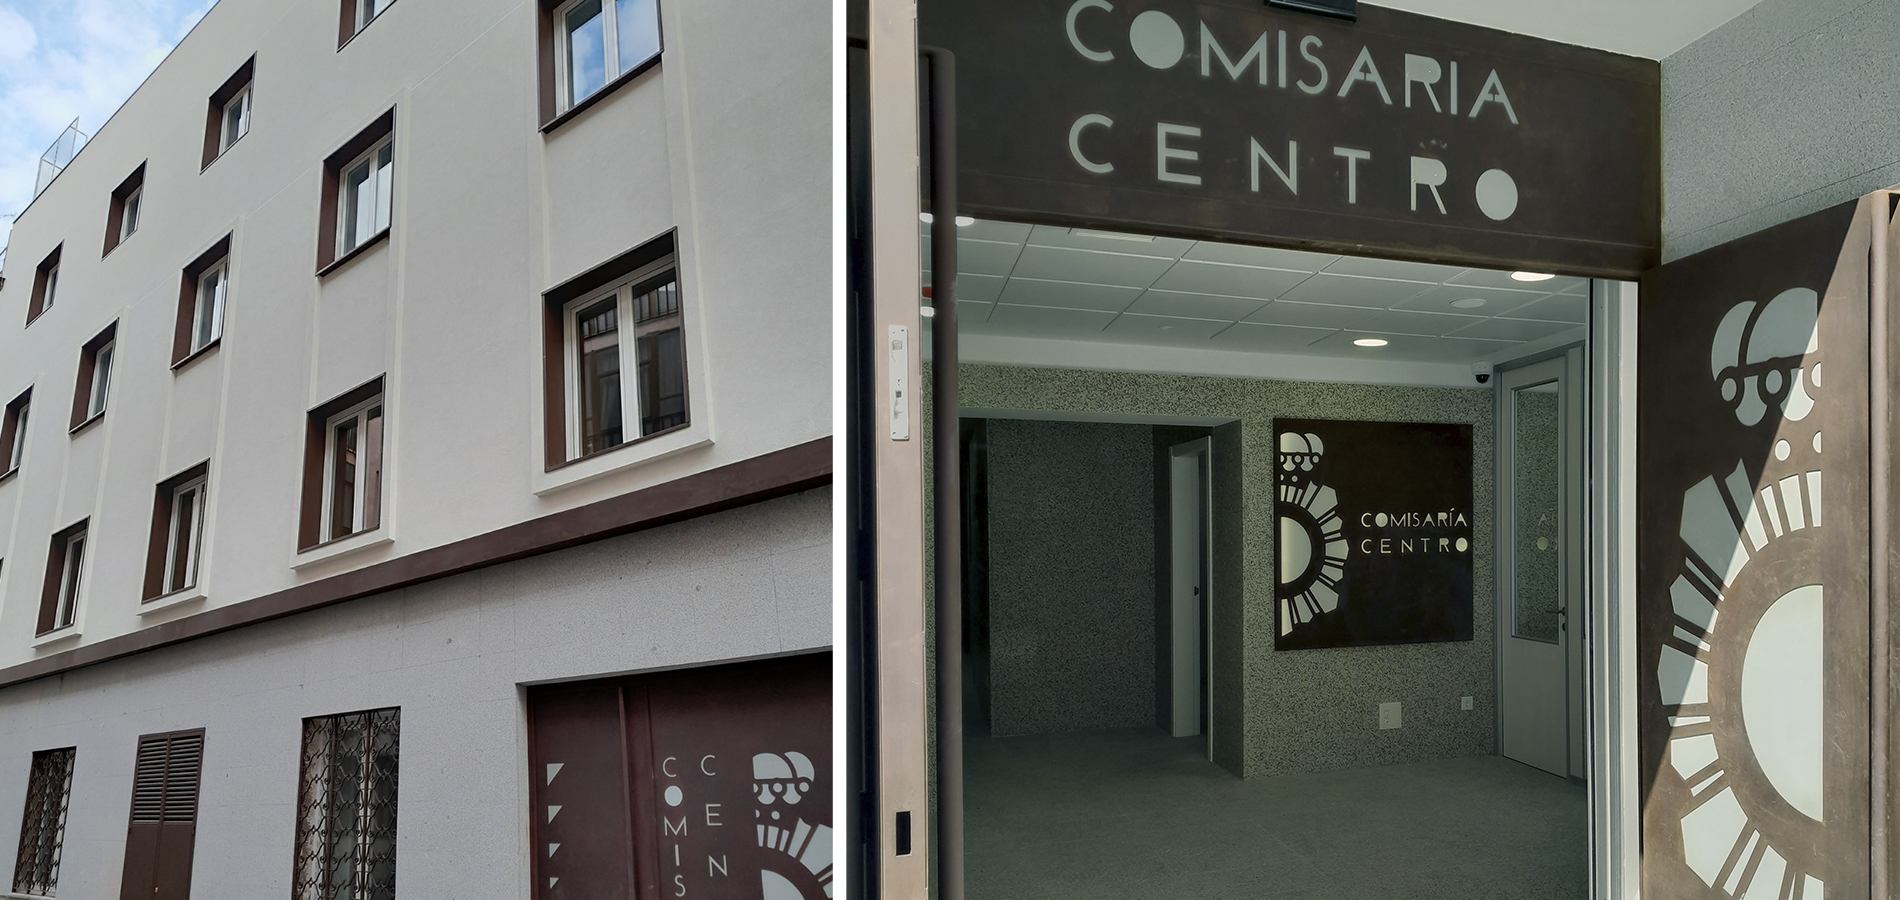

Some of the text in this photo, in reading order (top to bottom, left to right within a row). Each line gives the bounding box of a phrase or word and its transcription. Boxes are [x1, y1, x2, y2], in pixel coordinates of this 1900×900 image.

[1065, 0, 1519, 125] COMISARIA
[1068, 113, 1519, 221] CENTRO
[1360, 507, 1468, 528] COMISARÍA
[1360, 537, 1469, 554] CENTRO
[662, 756, 688, 898] COMIS
[700, 754, 728, 878] CEN
